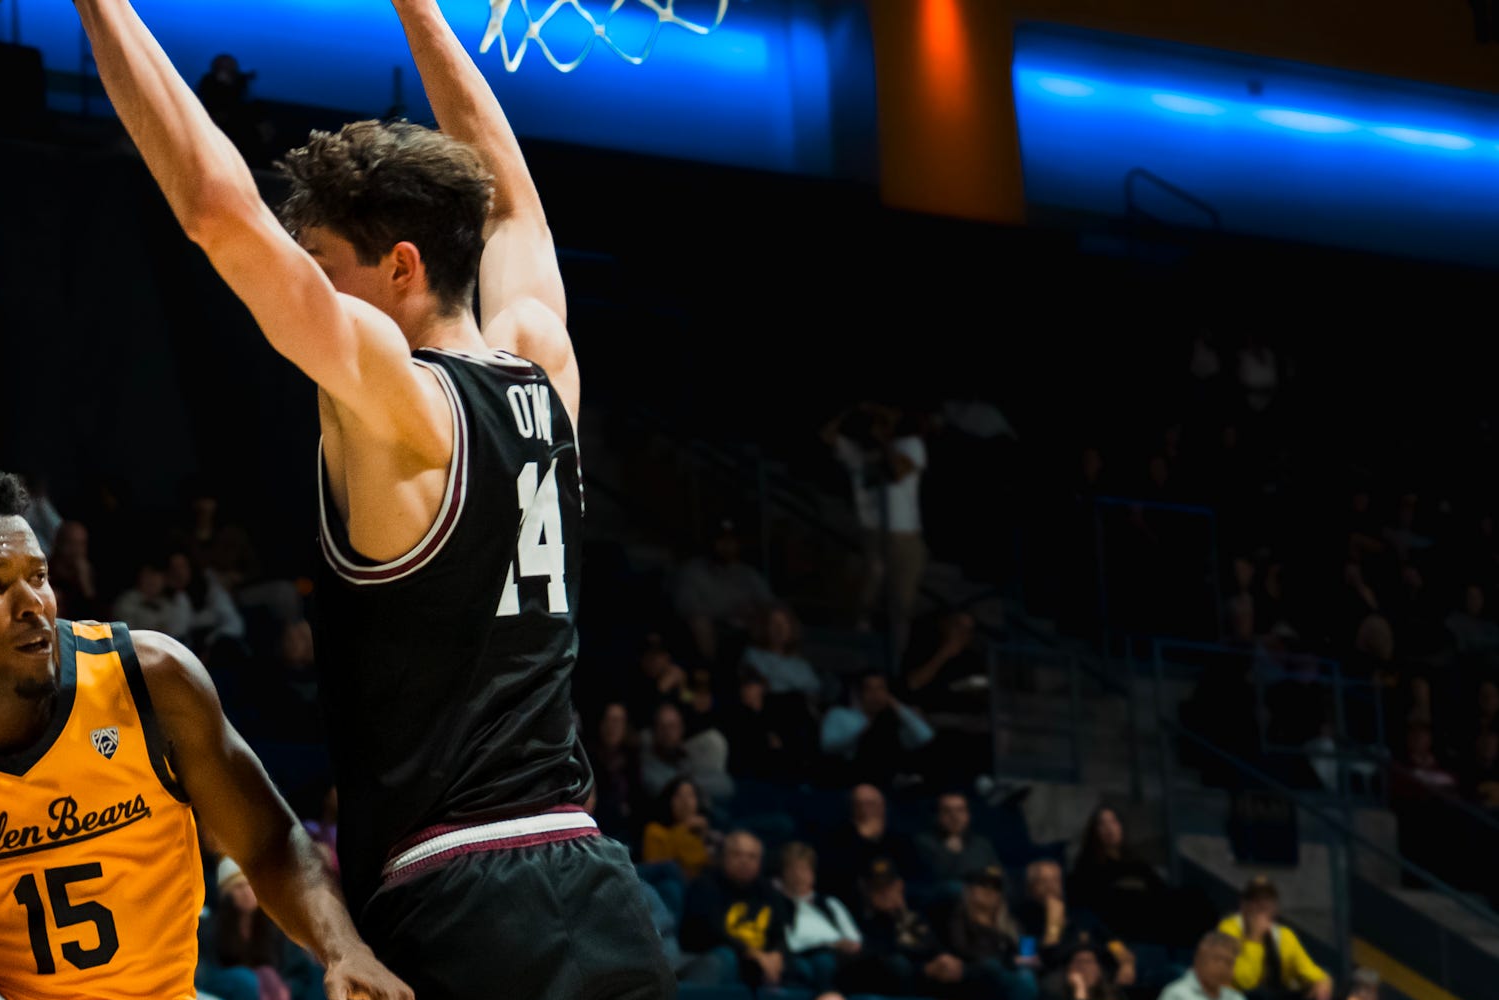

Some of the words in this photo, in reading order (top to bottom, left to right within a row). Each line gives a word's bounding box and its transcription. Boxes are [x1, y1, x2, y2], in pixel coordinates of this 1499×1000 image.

[491, 457, 566, 616] 14
[46, 794, 152, 842] Bears
[13, 861, 120, 975] 15
